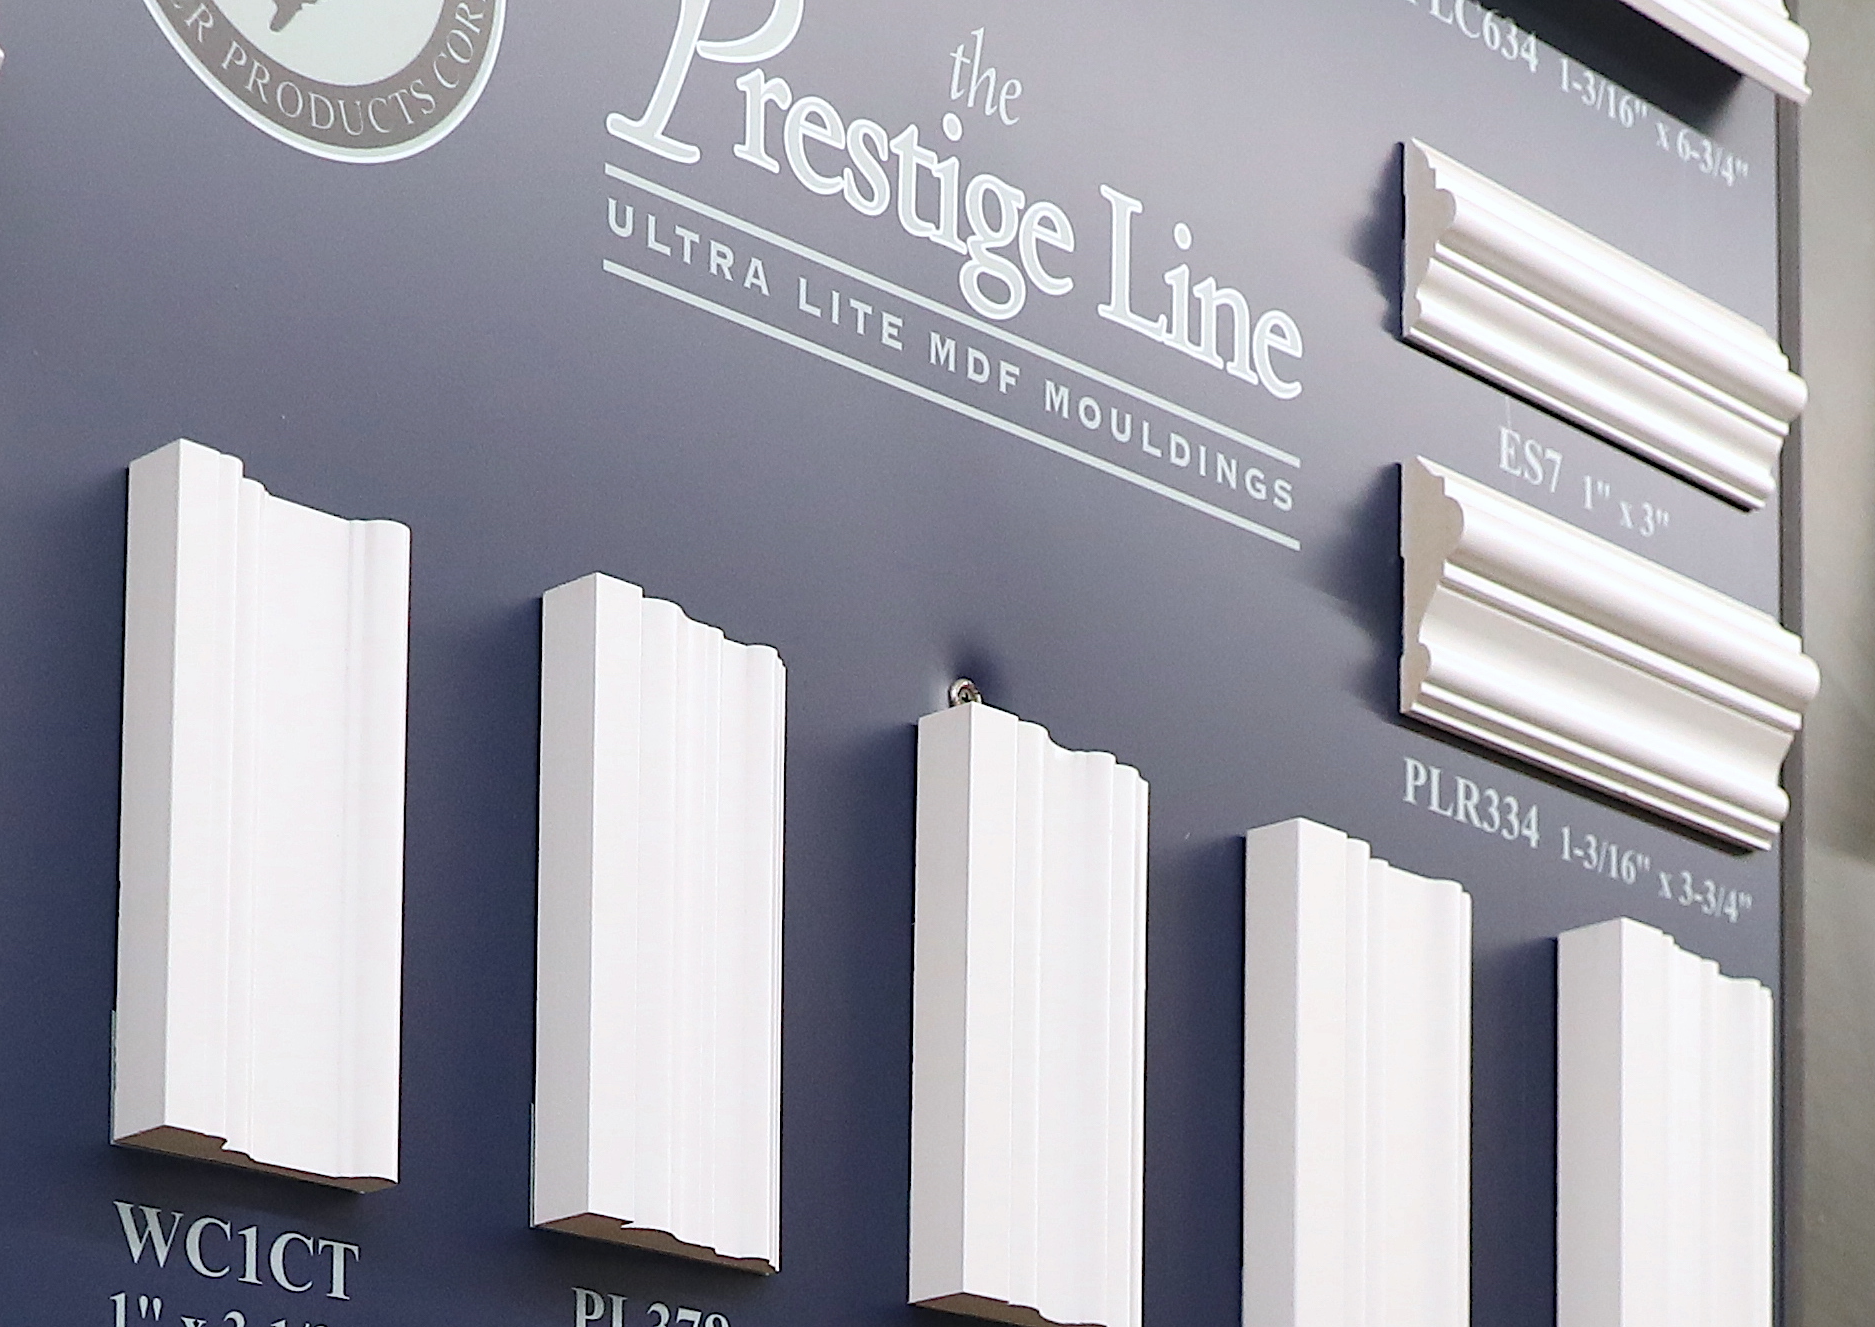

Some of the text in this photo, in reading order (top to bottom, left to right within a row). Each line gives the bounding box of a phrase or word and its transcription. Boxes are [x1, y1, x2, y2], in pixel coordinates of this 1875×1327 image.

[222, 0, 486, 135] PRODUCTS COR
[949, 27, 1022, 127] the
[1559, 56, 1647, 128] 1-3/16"
[1656, 122, 1669, 151] x
[1676, 128, 1748, 186] 6-3/4"
[606, 0, 1303, 399] Prestige Line
[607, 197, 1295, 512] ULTRA LITE MDF MOULDINGS
[1498, 426, 1669, 538] ES7 1" x 3"
[1403, 757, 1753, 921] PLR334 1-3/16" x 3-3/4"
[113, 1200, 360, 1300] WC1CT
